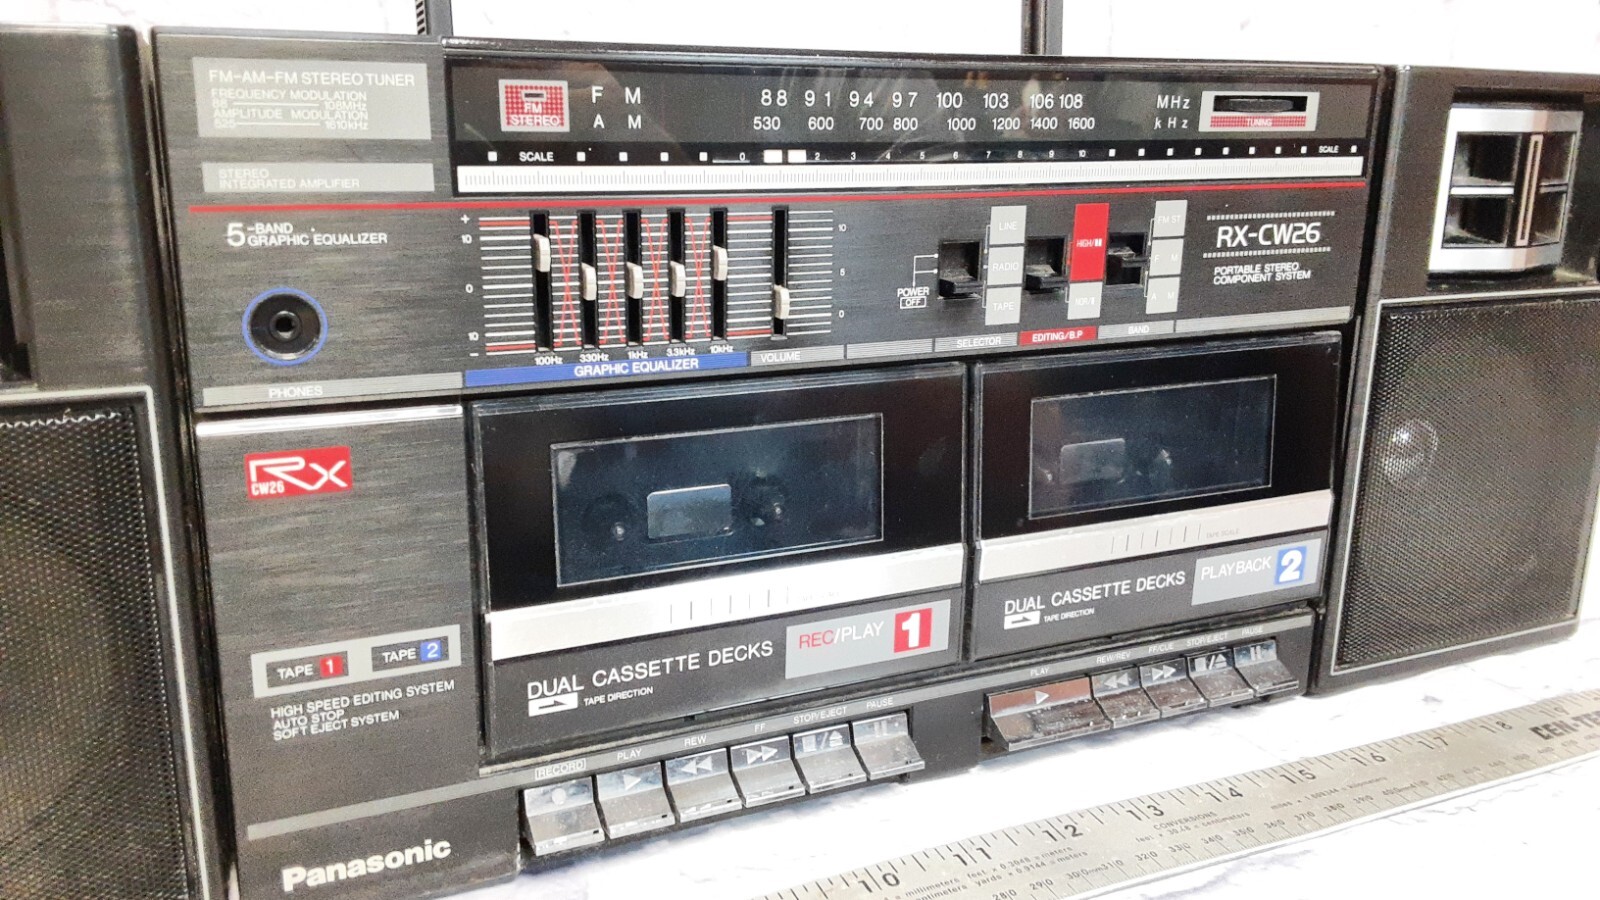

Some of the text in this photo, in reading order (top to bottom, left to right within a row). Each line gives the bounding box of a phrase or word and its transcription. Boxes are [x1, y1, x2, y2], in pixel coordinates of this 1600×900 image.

[209, 70, 415, 87] FM-AM-FM STEREO TUNER
[211, 88, 367, 101] FREQUENCY MODULATION
[936, 92, 963, 109] 100
[983, 93, 1009, 109] 103
[1030, 94, 1054, 109] 106
[1058, 94, 1083, 110] 108
[524, 102, 542, 114] FM
[1156, 94, 1190, 110] MHz
[213, 108, 368, 120] AMPLITUDE MODULATION
[510, 115, 560, 126] STEREO
[753, 117, 1095, 131] 530 600 700 800 1000 1200 1400 1600
[1154, 117, 1188, 130] kHz
[1246, 118, 1272, 127] TUNING
[739, 152, 746, 161] 0
[814, 152, 820, 161] 2
[850, 152, 857, 161] 3
[885, 151, 891, 160] 4
[919, 151, 925, 160] 5
[953, 151, 959, 159] 6
[986, 150, 991, 159] 7
[1017, 150, 1023, 159] 8
[1049, 150, 1055, 158] 9
[1318, 145, 1340, 153] SCALE
[519, 152, 554, 162] SCALE
[219, 168, 269, 179] STEREO
[219, 178, 360, 189] INTEGRATED AMPLIFIER
[999, 221, 1017, 231] LINE
[1158, 215, 1181, 224] FM ST
[247, 232, 388, 247] GRAPHIC EQUALIZER
[461, 235, 473, 244] 10
[1216, 222, 1321, 248] RX-CW26
[992, 262, 1019, 271] RADIO
[1214, 262, 1300, 276] PORTABLE STEREO
[1213, 270, 1311, 285] COMPONENT SYSTEM
[465, 284, 474, 293] 0
[897, 286, 930, 297] POWER
[905, 298, 922, 307] OFF
[993, 302, 1015, 311] TAPE
[468, 332, 479, 341] 10
[1128, 325, 1150, 335] BAND
[957, 337, 1002, 348] SELECTOR
[535, 355, 563, 365] 100Hz
[579, 353, 609, 363] 330Hz
[628, 350, 649, 360] 1kHz
[710, 344, 734, 354] 10kHz
[760, 351, 801, 363] VOLUME
[574, 359, 699, 377] GRAPHIC EQUALIZER
[268, 385, 323, 399] PHONES
[251, 480, 285, 496] CW26
[1200, 556, 1272, 581] PLAYBACK
[1278, 550, 1303, 583] 2
[1004, 571, 1186, 616] DUAL CASSETTE DECKS
[1044, 607, 1095, 623] TAPE DIRECTION
[799, 621, 884, 650] REC/PLAY
[901, 612, 920, 648] 1
[1241, 625, 1264, 636] PAUSE
[1186, 632, 1229, 647] STOP/EJECT
[382, 642, 439, 663] TAPE 2
[1148, 642, 1174, 654] FF/CUE
[1096, 651, 1131, 664] REW/REV
[277, 664, 313, 680] TAPE
[527, 640, 773, 700] DUAL CASSETTE DECKS
[1030, 666, 1049, 677] PLAY
[271, 679, 455, 719] HIGH SPEED EDITING SYSTEM
[583, 686, 654, 707] TAPE DIRECTION
[866, 697, 894, 710] PAUSE
[273, 709, 345, 730] AUTO STOP
[793, 706, 848, 725] STOP/EJECT
[273, 710, 399, 741] SOFT EJECT SYSTEM
[754, 723, 766, 733] FF
[1529, 710, 1600, 740] CEN-TE
[684, 735, 707, 747] REW
[1417, 736, 1449, 750] 17
[617, 748, 642, 761] PLAY
[1350, 752, 1386, 767] 16
[537, 761, 583, 777] RECORD
[1279, 769, 1316, 784] 15
[1205, 787, 1243, 803] 14
[1126, 804, 1165, 821] 13
[1153, 811, 1218, 831] CONVERSIONS
[1042, 823, 1083, 842] 12
[953, 846, 992, 867] 11
[281, 839, 452, 893] Panasonic
[858, 872, 900, 894] 10
